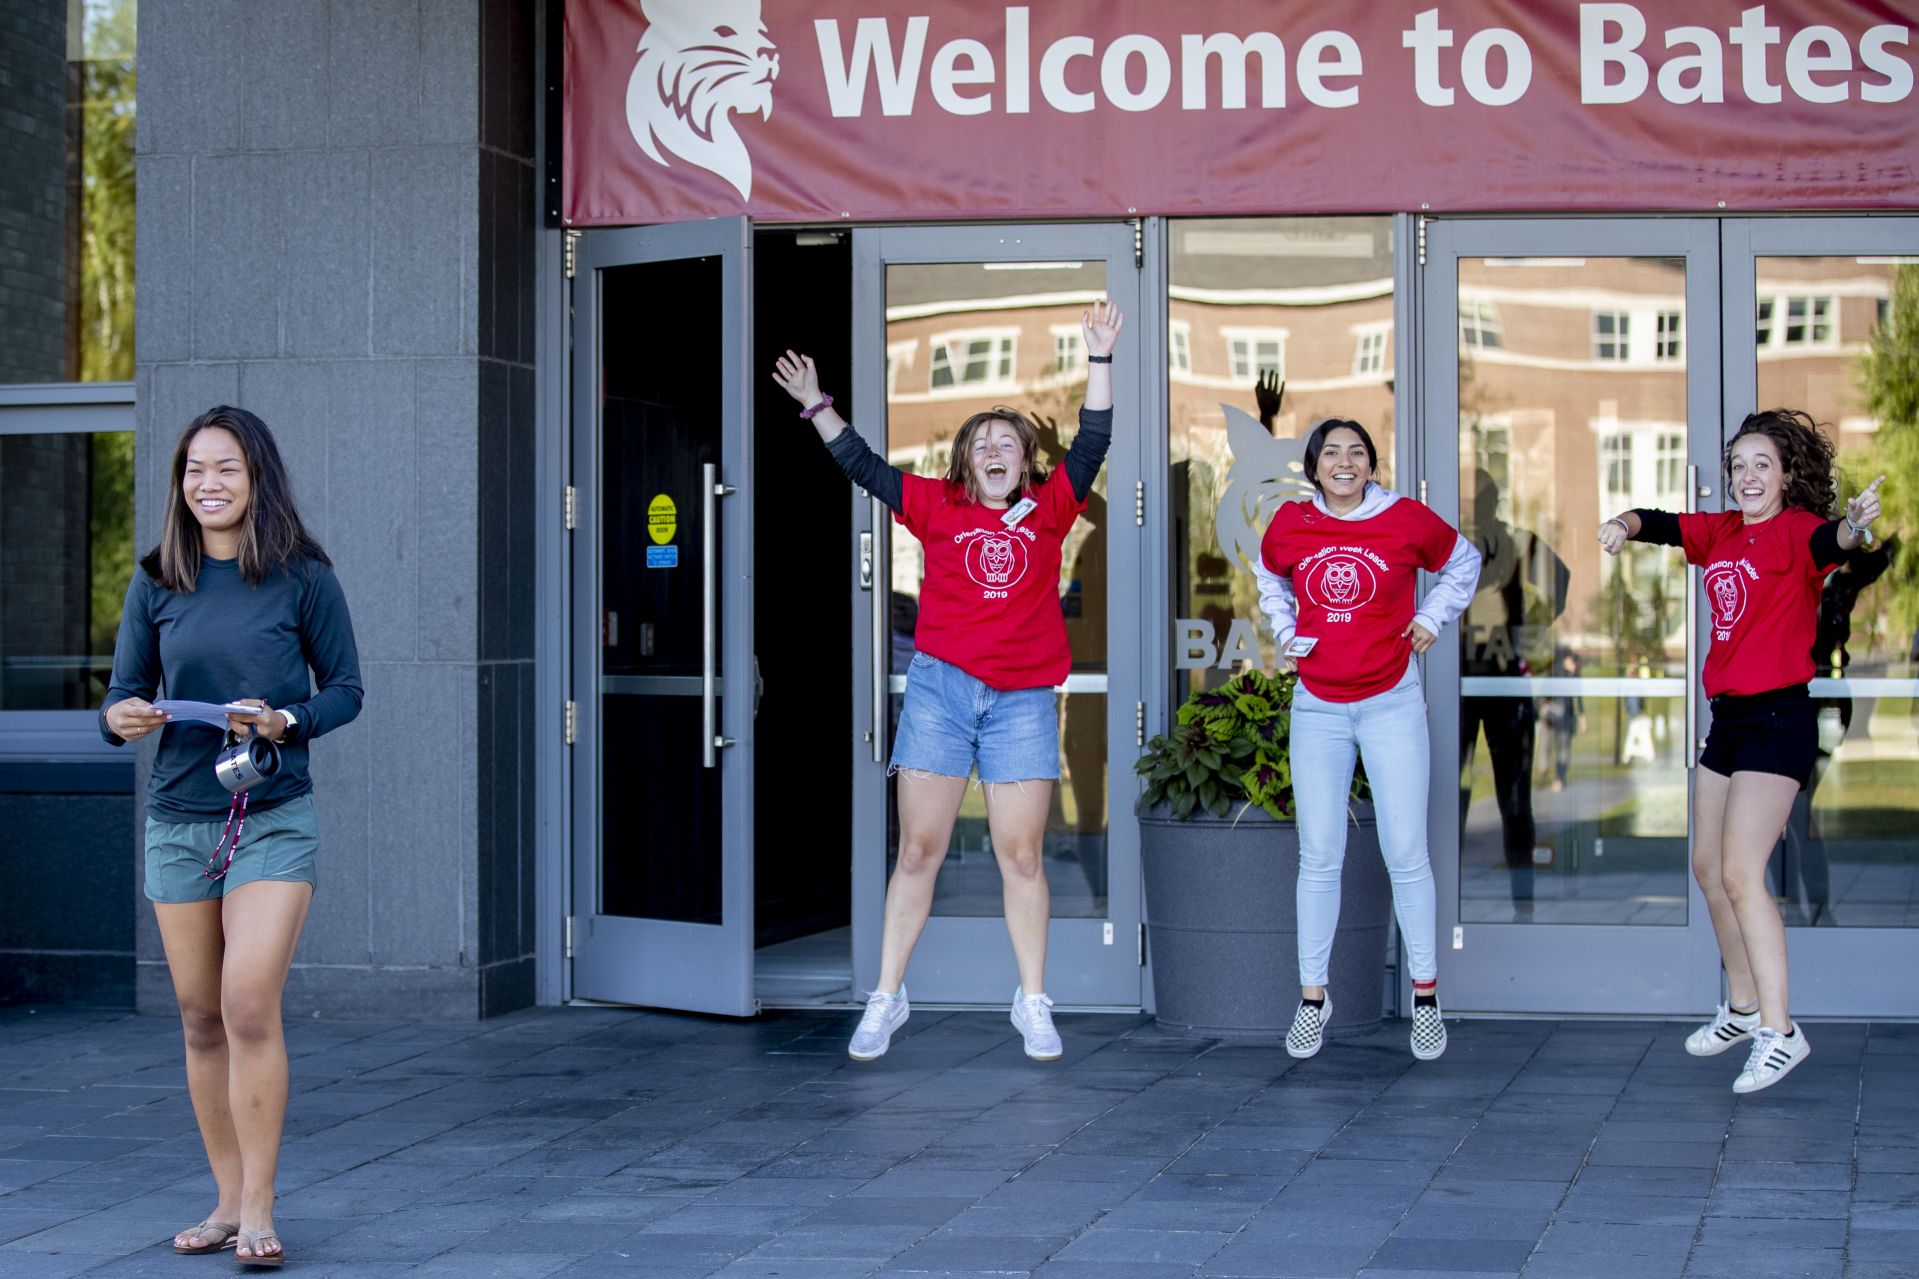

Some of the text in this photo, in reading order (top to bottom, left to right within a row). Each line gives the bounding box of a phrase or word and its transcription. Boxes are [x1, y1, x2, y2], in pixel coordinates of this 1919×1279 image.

[814, 2, 1914, 117] Welcome to Bates
[649, 515, 676, 524] CAUTION
[1363, 548, 1390, 572] Leader
[983, 590, 1008, 599] 2019
[1326, 613, 1352, 623] 2019
[229, 747, 244, 781] BATES
